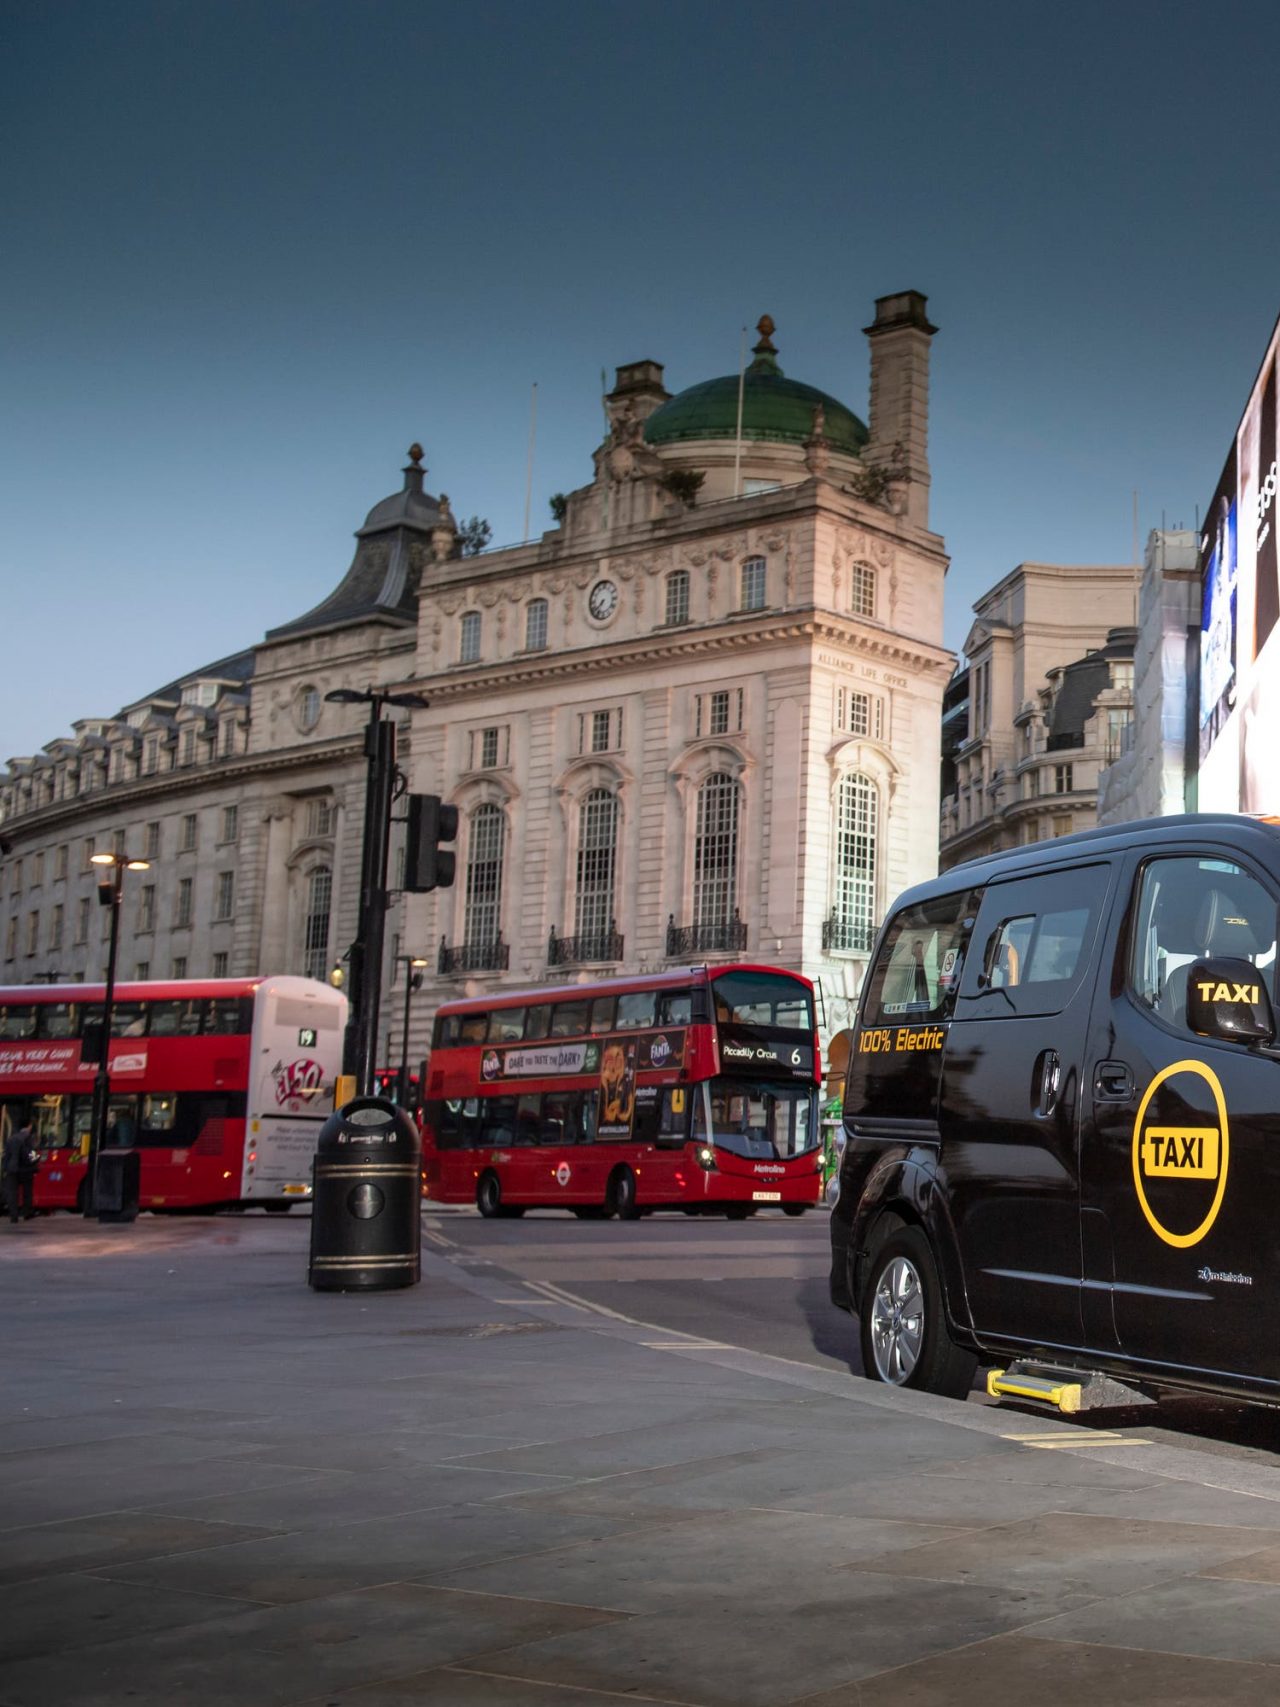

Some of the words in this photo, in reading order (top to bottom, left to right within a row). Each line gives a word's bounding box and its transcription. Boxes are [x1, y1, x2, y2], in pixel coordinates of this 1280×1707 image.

[1197, 982, 1259, 1005] TAXI
[859, 1029, 891, 1053] 100%
[895, 1026, 944, 1051] Electric
[723, 1045, 754, 1060] Piccadilly
[756, 1048, 777, 1060] Circus
[791, 1048, 801, 1065] 6
[1150, 1136, 1204, 1169] TAXI
[754, 1163, 786, 1174] Metroline
